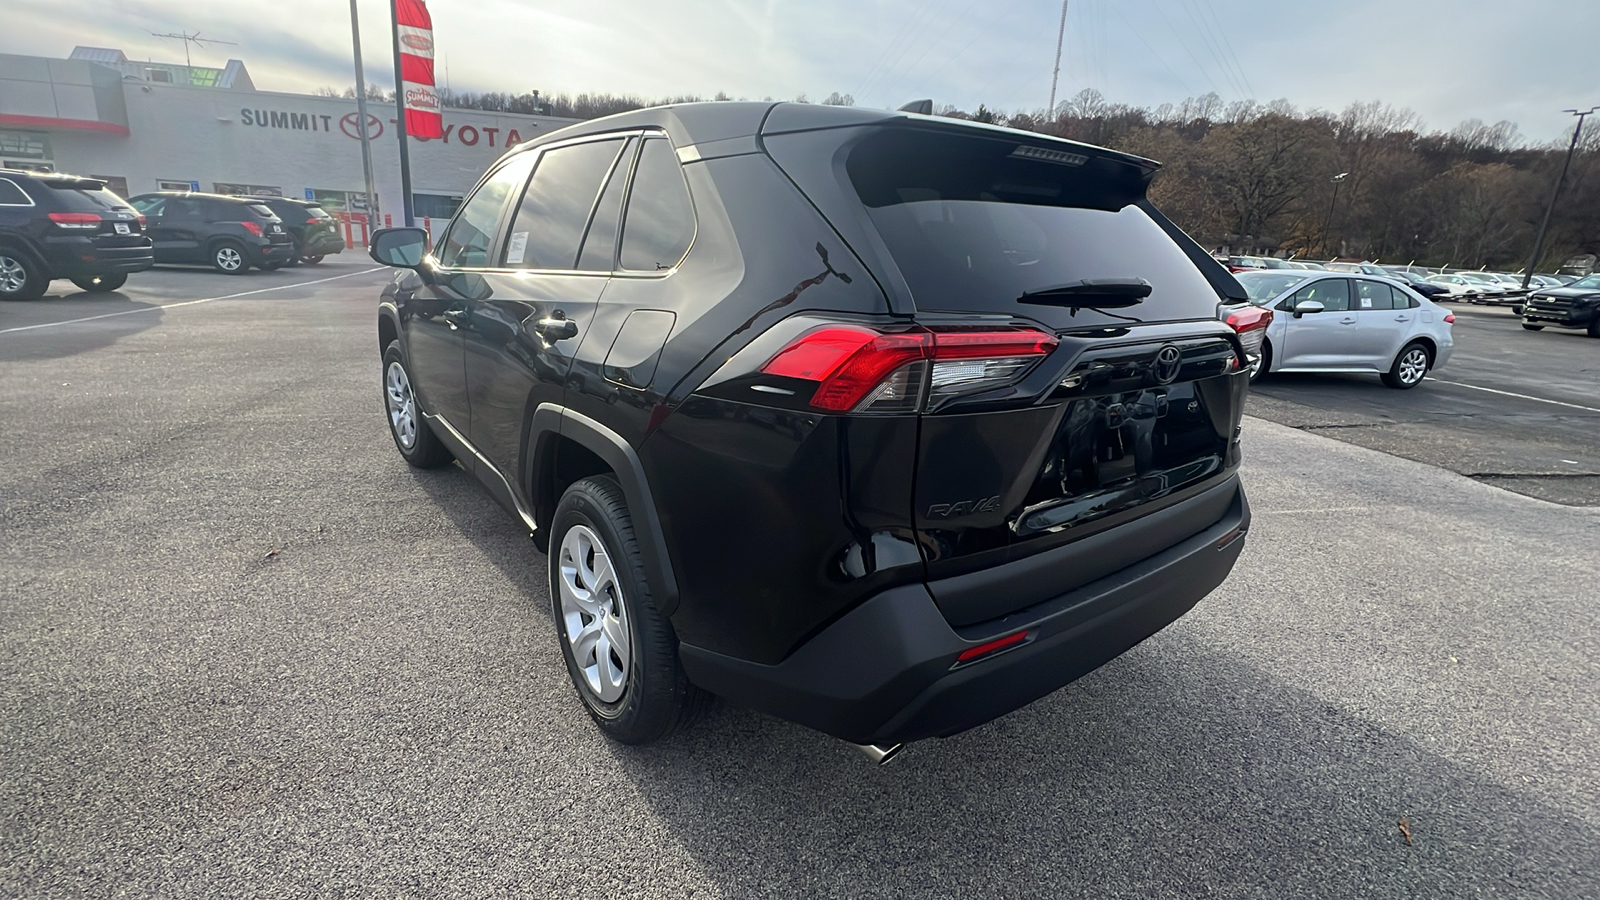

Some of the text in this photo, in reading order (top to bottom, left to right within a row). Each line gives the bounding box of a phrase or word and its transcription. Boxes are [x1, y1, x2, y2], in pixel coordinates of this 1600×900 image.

[406, 90, 439, 108] SUMMIT
[240, 108, 523, 148] SUMMIT YOTA
[925, 495, 1001, 518] RAV4
